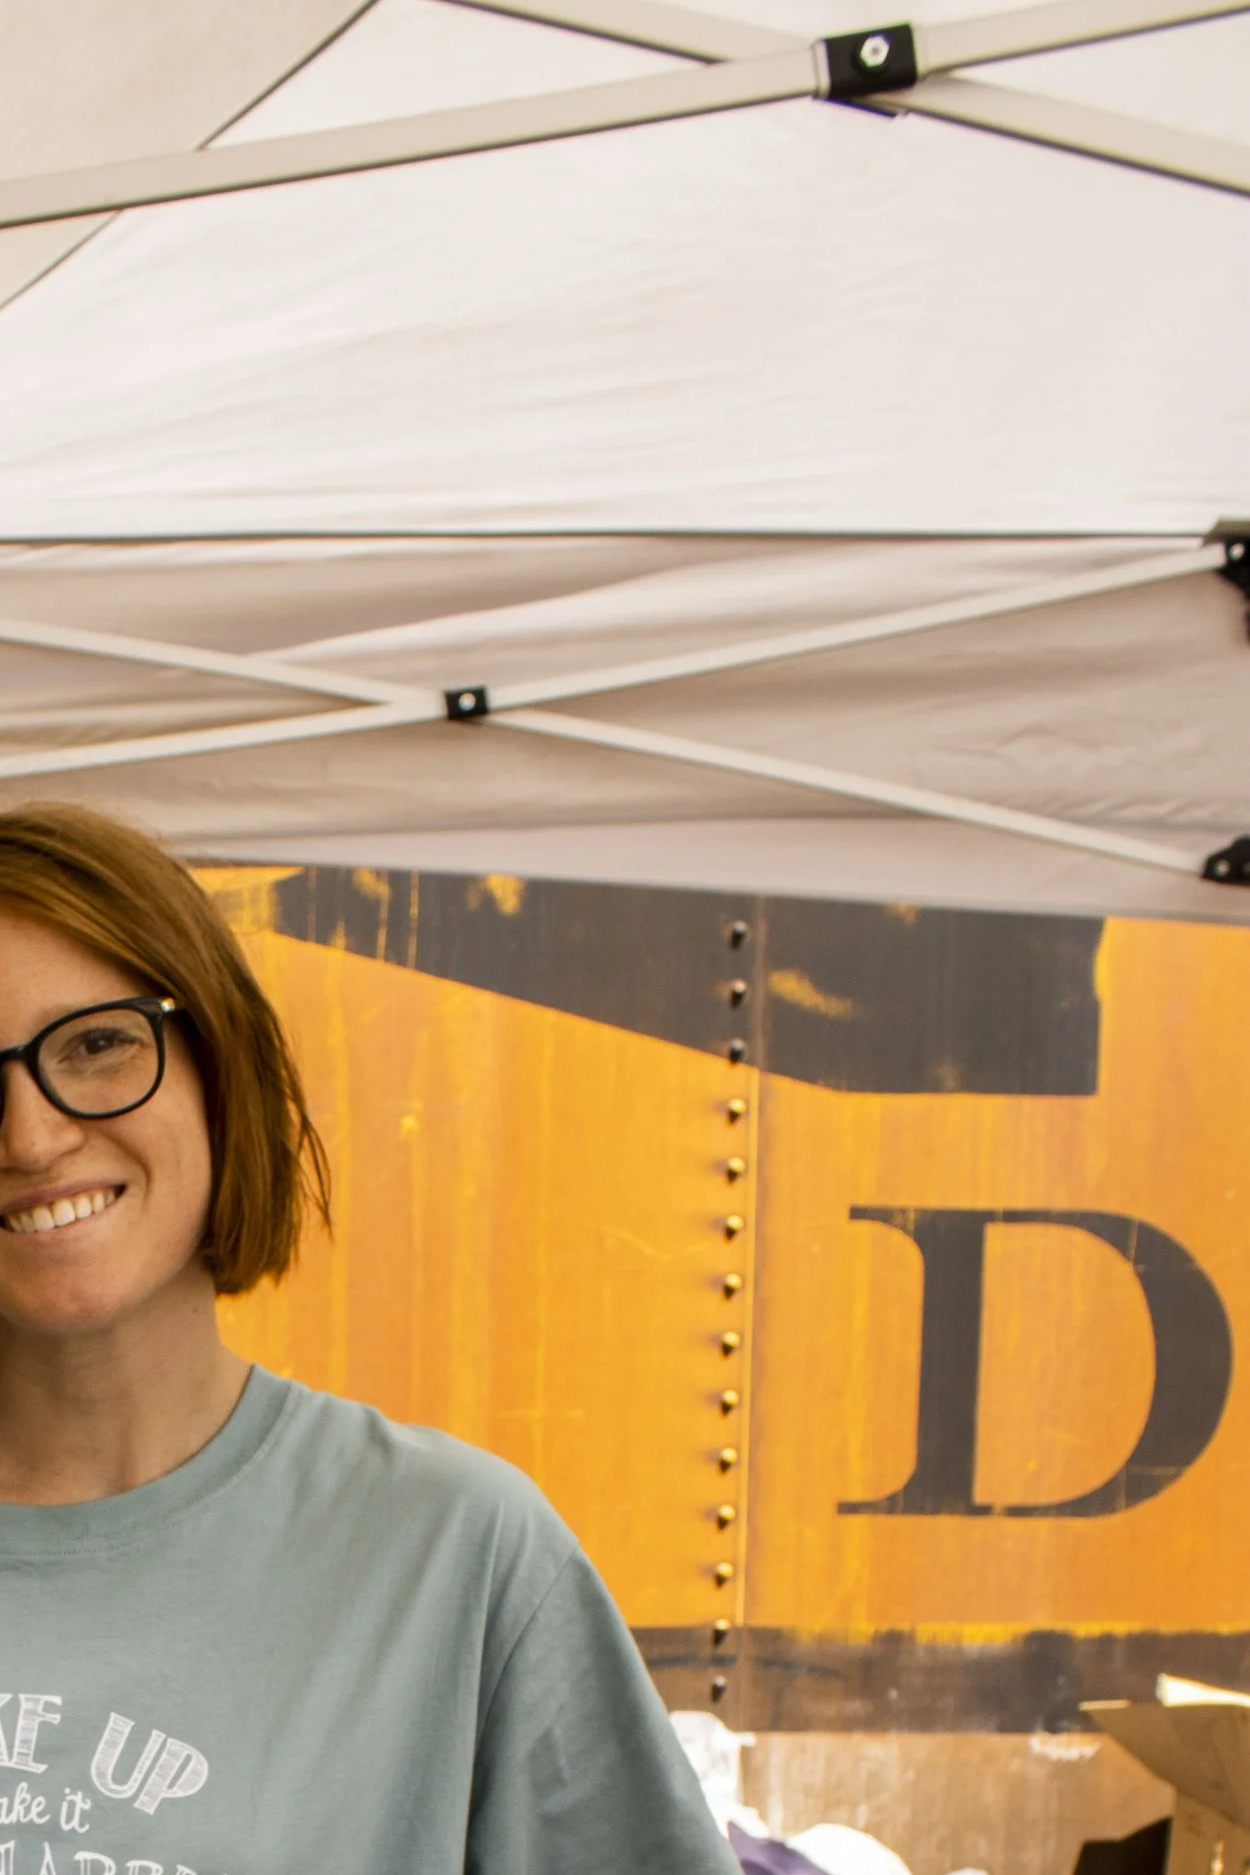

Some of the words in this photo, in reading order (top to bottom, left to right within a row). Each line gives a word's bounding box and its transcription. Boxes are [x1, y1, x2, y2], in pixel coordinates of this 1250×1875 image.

[837, 1205, 1236, 1519] D
[59, 1788, 92, 1833] it
[90, 1712, 209, 1815] UP
